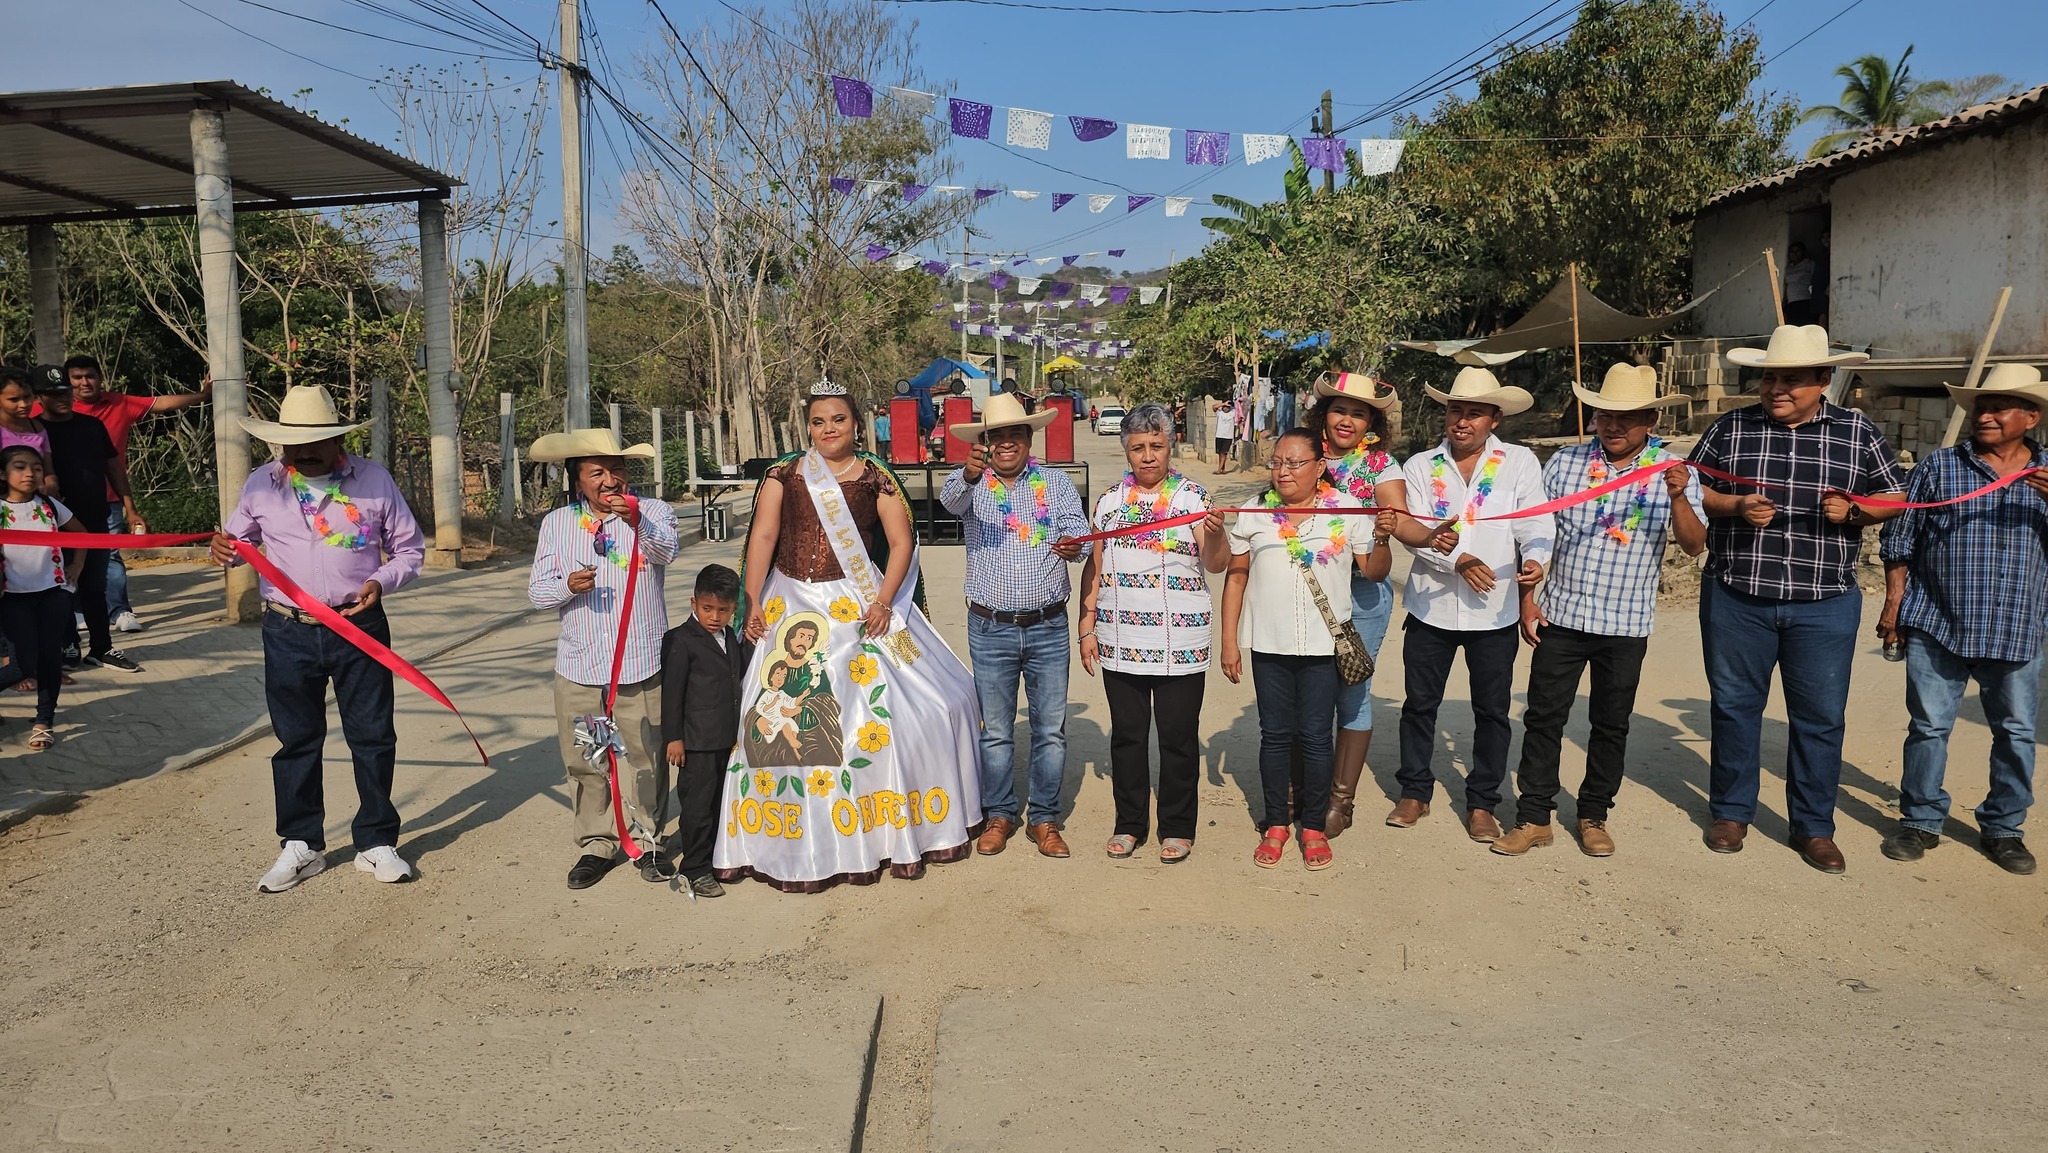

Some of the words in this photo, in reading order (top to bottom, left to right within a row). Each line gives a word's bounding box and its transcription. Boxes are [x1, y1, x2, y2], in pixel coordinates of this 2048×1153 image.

[836, 527, 856, 551] LA
[847, 553, 880, 605] MISIO
[728, 798, 803, 839] JOSE
[831, 786, 950, 837] OBRERO
